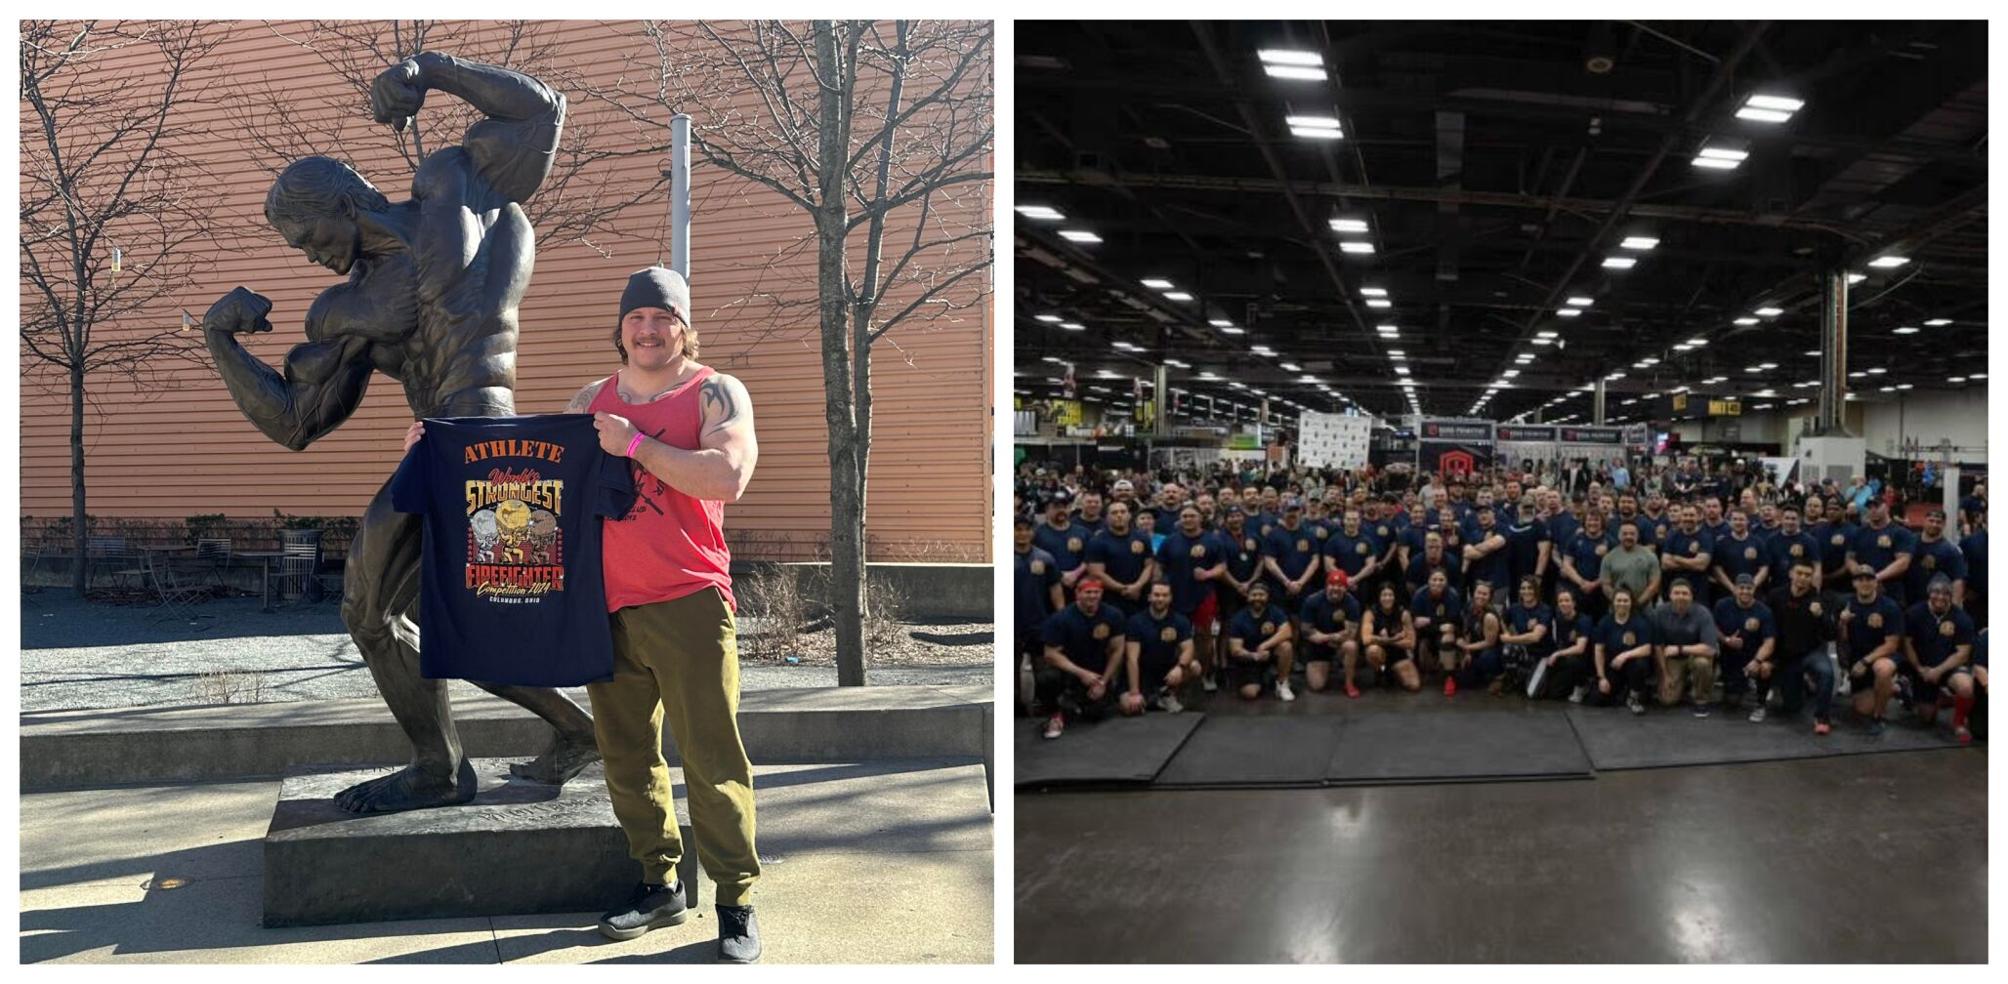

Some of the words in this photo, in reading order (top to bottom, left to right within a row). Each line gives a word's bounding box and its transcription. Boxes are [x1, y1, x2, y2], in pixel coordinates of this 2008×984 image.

[465, 440, 564, 464] ATHLETE
[466, 480, 564, 517] STRONGEST
[466, 564, 564, 592] FIREFIGHTER
[477, 580, 526, 597] Competition
